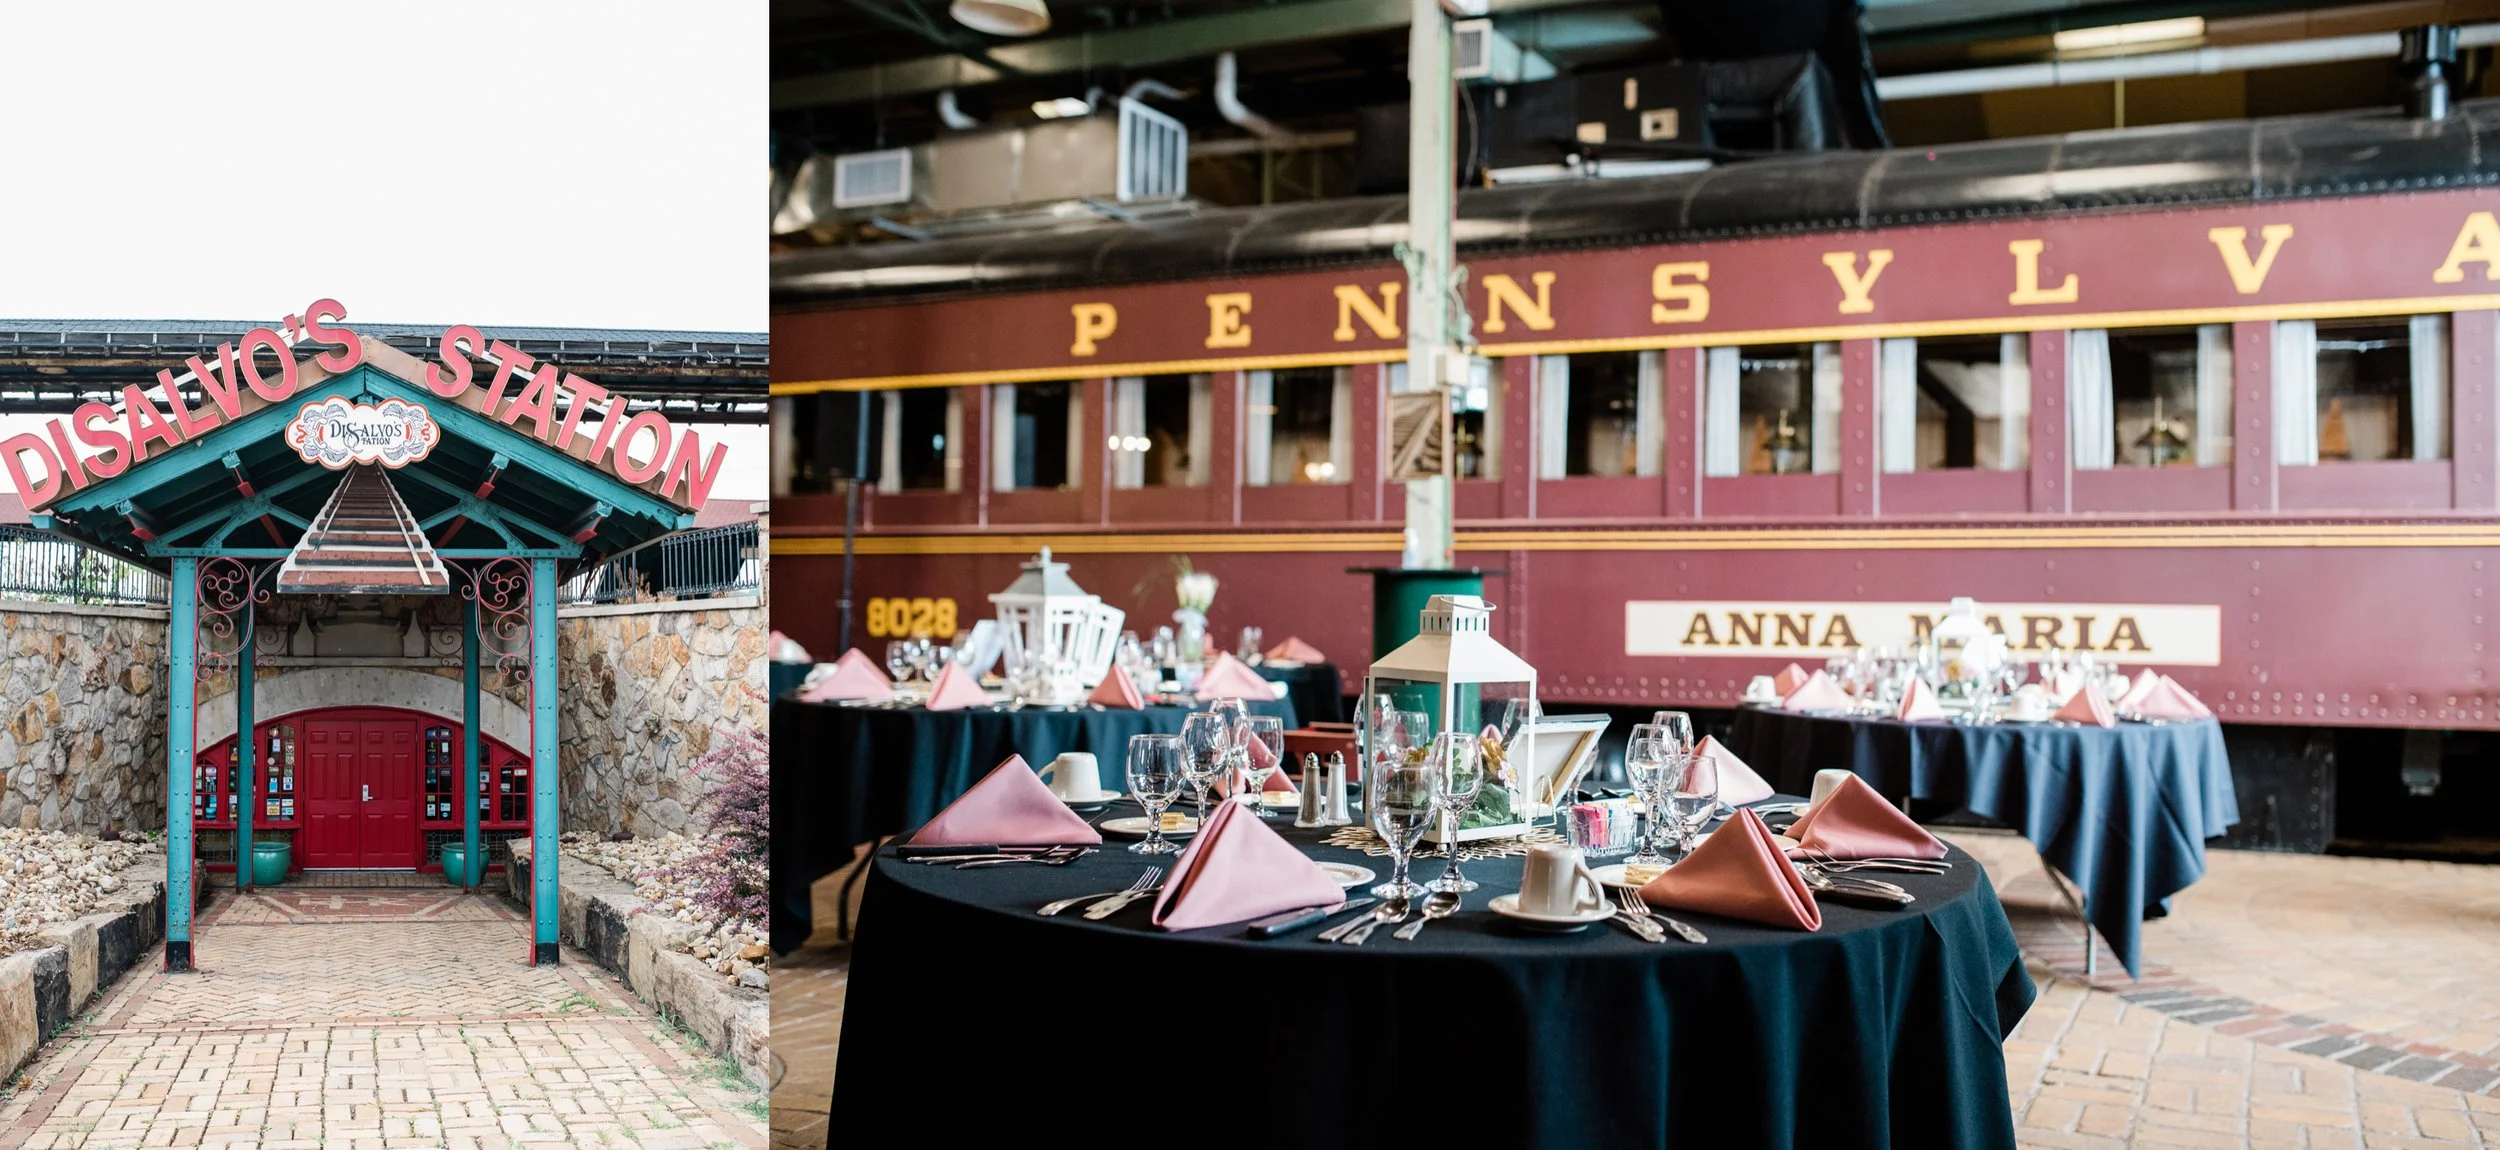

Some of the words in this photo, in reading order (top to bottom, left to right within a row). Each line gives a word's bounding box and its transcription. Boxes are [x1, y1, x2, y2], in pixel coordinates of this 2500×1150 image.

[0, 298, 363, 513] DISALVO'S
[425, 324, 728, 512] STATION
[867, 597, 957, 638] 8028
[1681, 612, 1863, 648] ANNA
